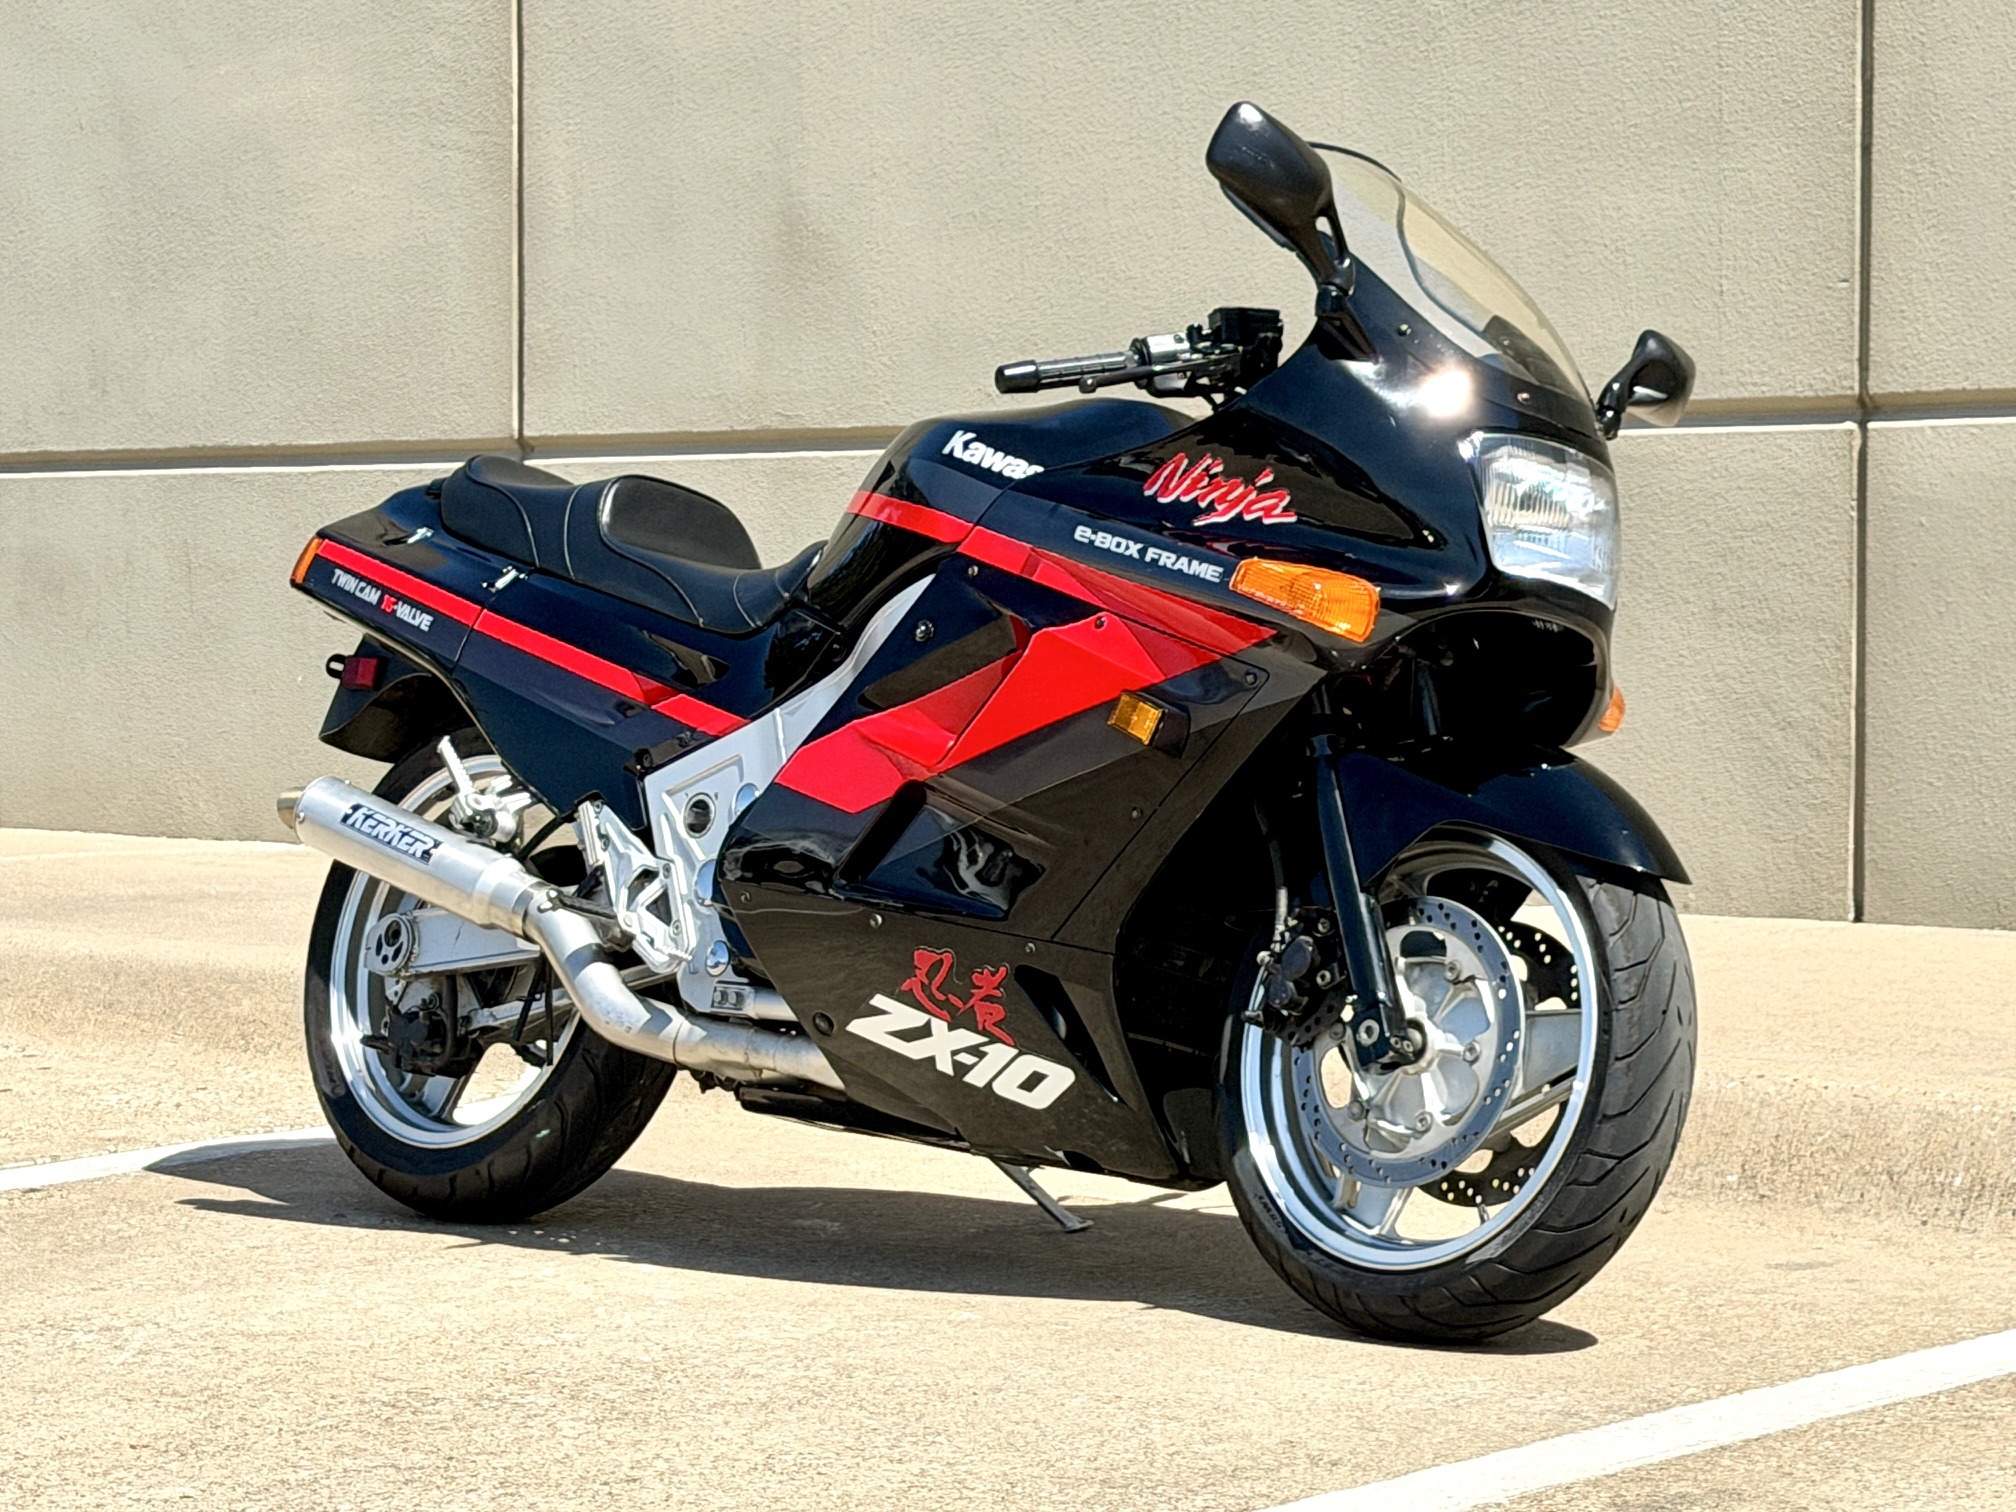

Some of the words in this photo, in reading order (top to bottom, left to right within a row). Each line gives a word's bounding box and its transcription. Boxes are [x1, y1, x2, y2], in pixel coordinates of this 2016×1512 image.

[1143, 452, 1298, 526] Ninja
[331, 568, 360, 594] TWIN
[354, 581, 382, 606] CAM
[1144, 546, 1225, 583] FRAME
[345, 806, 435, 858] KERKER
[901, 948, 1016, 1048] 忍者
[845, 993, 1076, 1110] ZX-10
